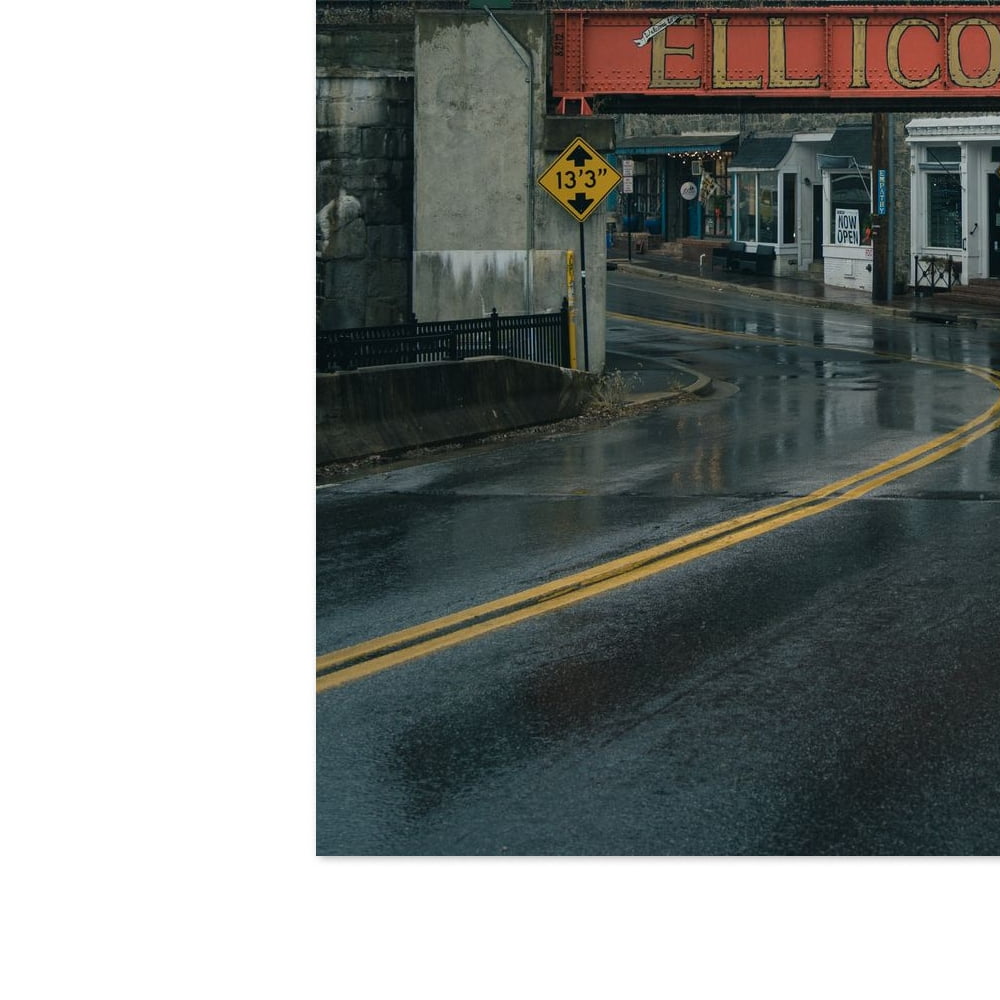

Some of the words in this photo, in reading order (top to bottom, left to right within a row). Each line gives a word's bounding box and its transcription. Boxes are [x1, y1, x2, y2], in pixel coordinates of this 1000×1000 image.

[556, 168, 607, 190] 13'3"
[838, 215, 857, 229] NOW
[837, 230, 859, 245] OPEN
